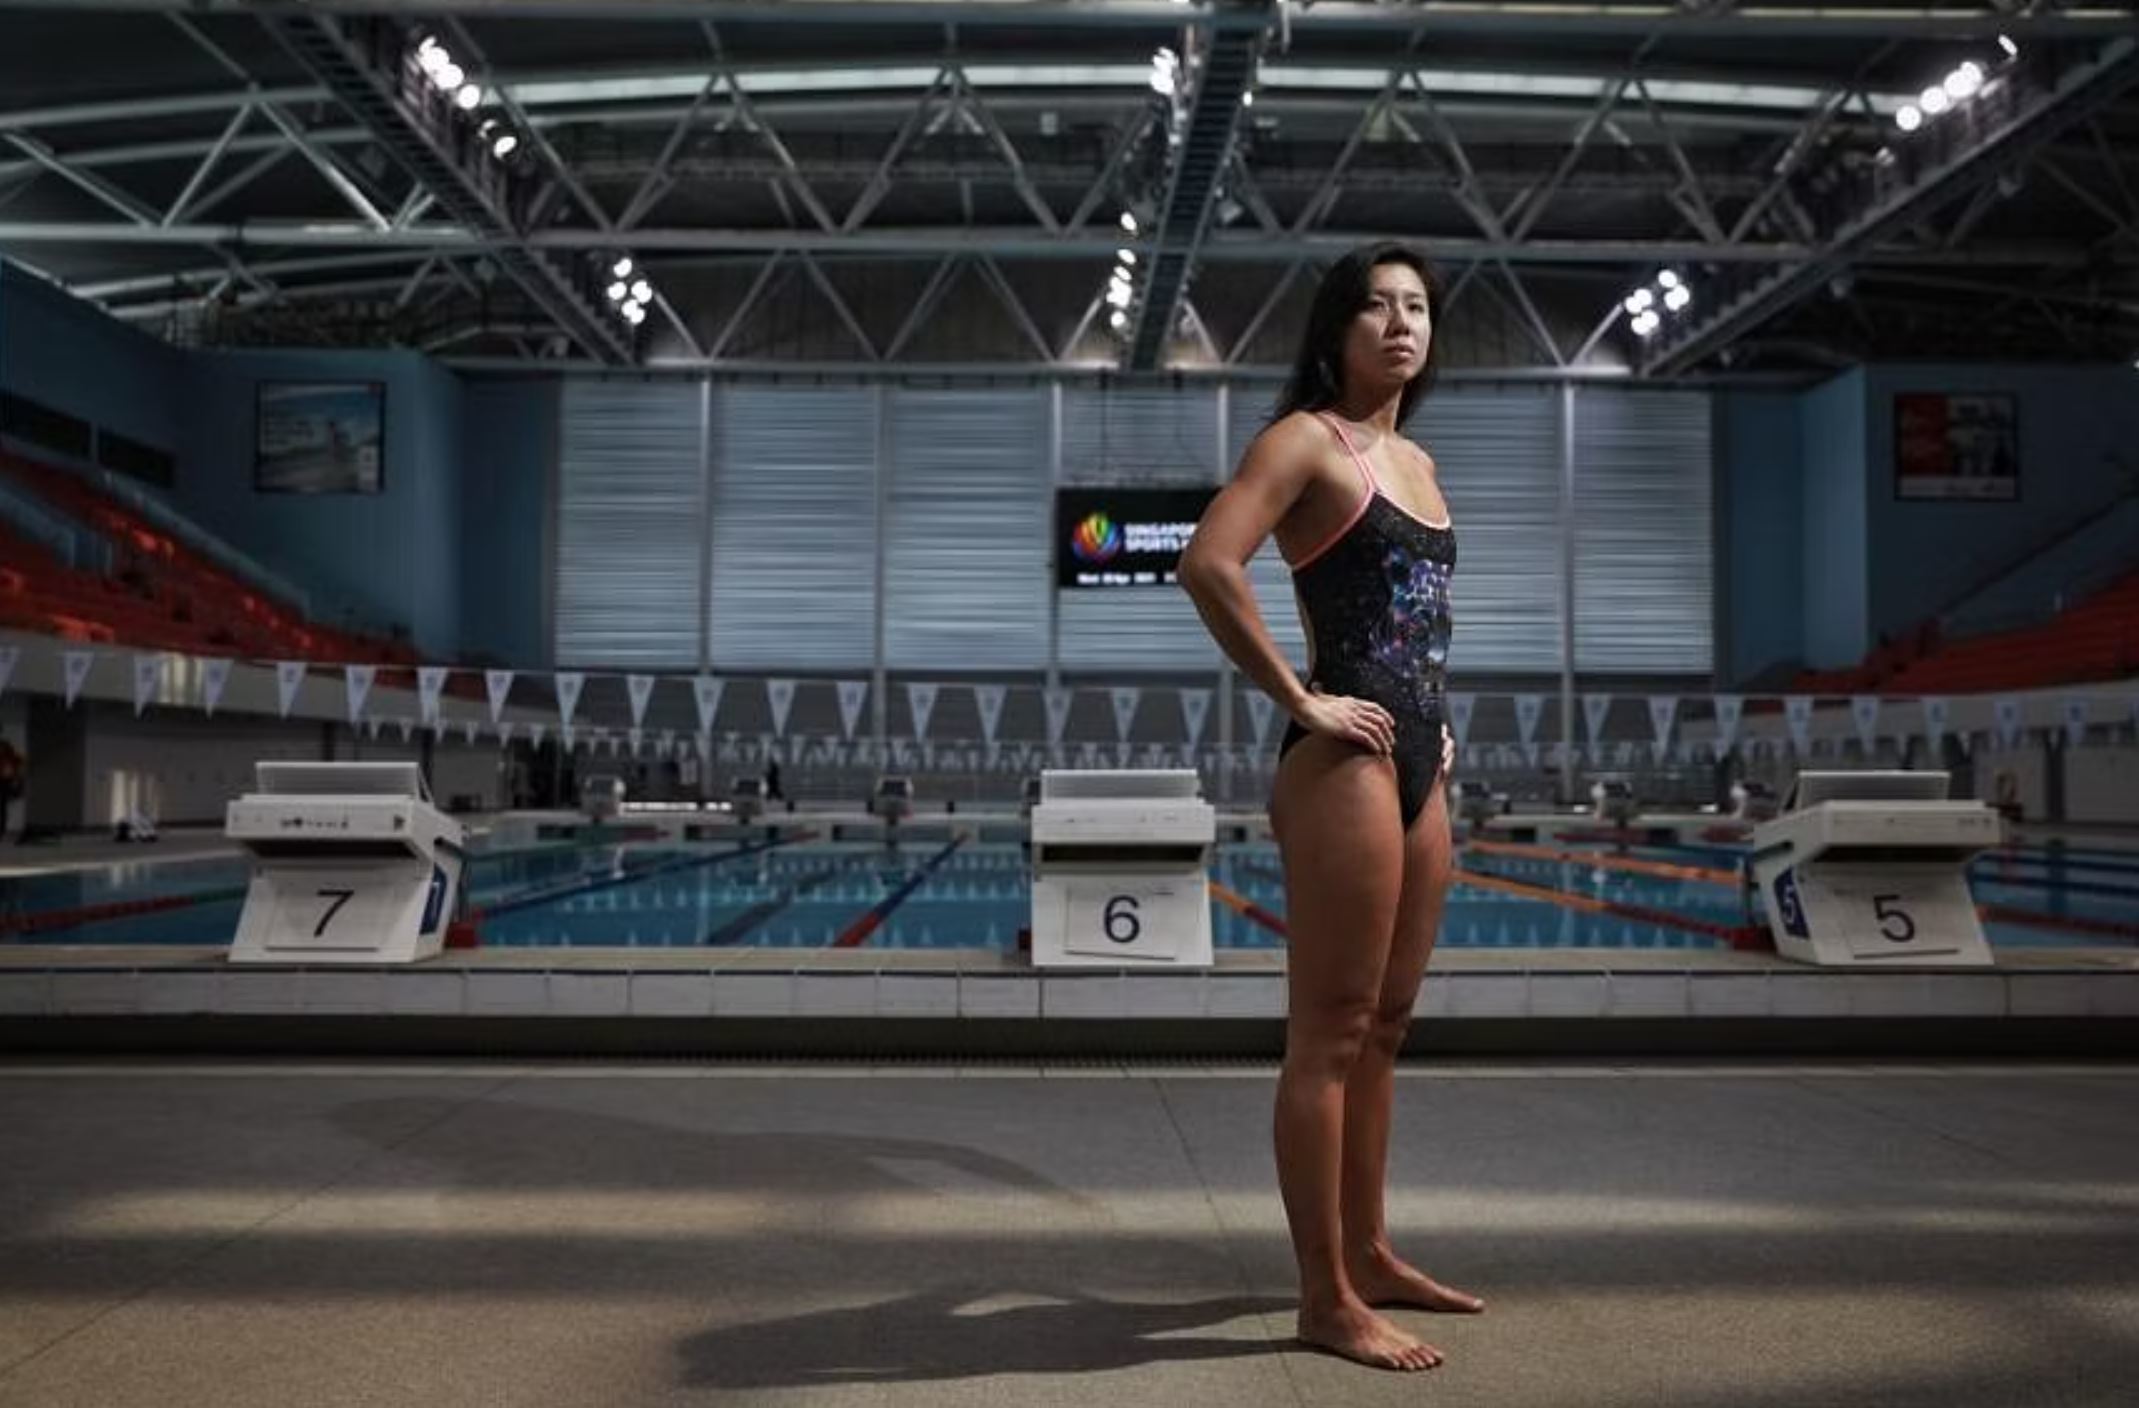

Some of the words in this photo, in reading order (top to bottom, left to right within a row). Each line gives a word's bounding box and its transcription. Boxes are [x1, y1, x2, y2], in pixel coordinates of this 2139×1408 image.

[1124, 523, 1198, 537] SINGAPOR
[314, 889, 355, 938] 7
[1103, 894, 1140, 944] 6
[1873, 894, 1915, 942] 5
